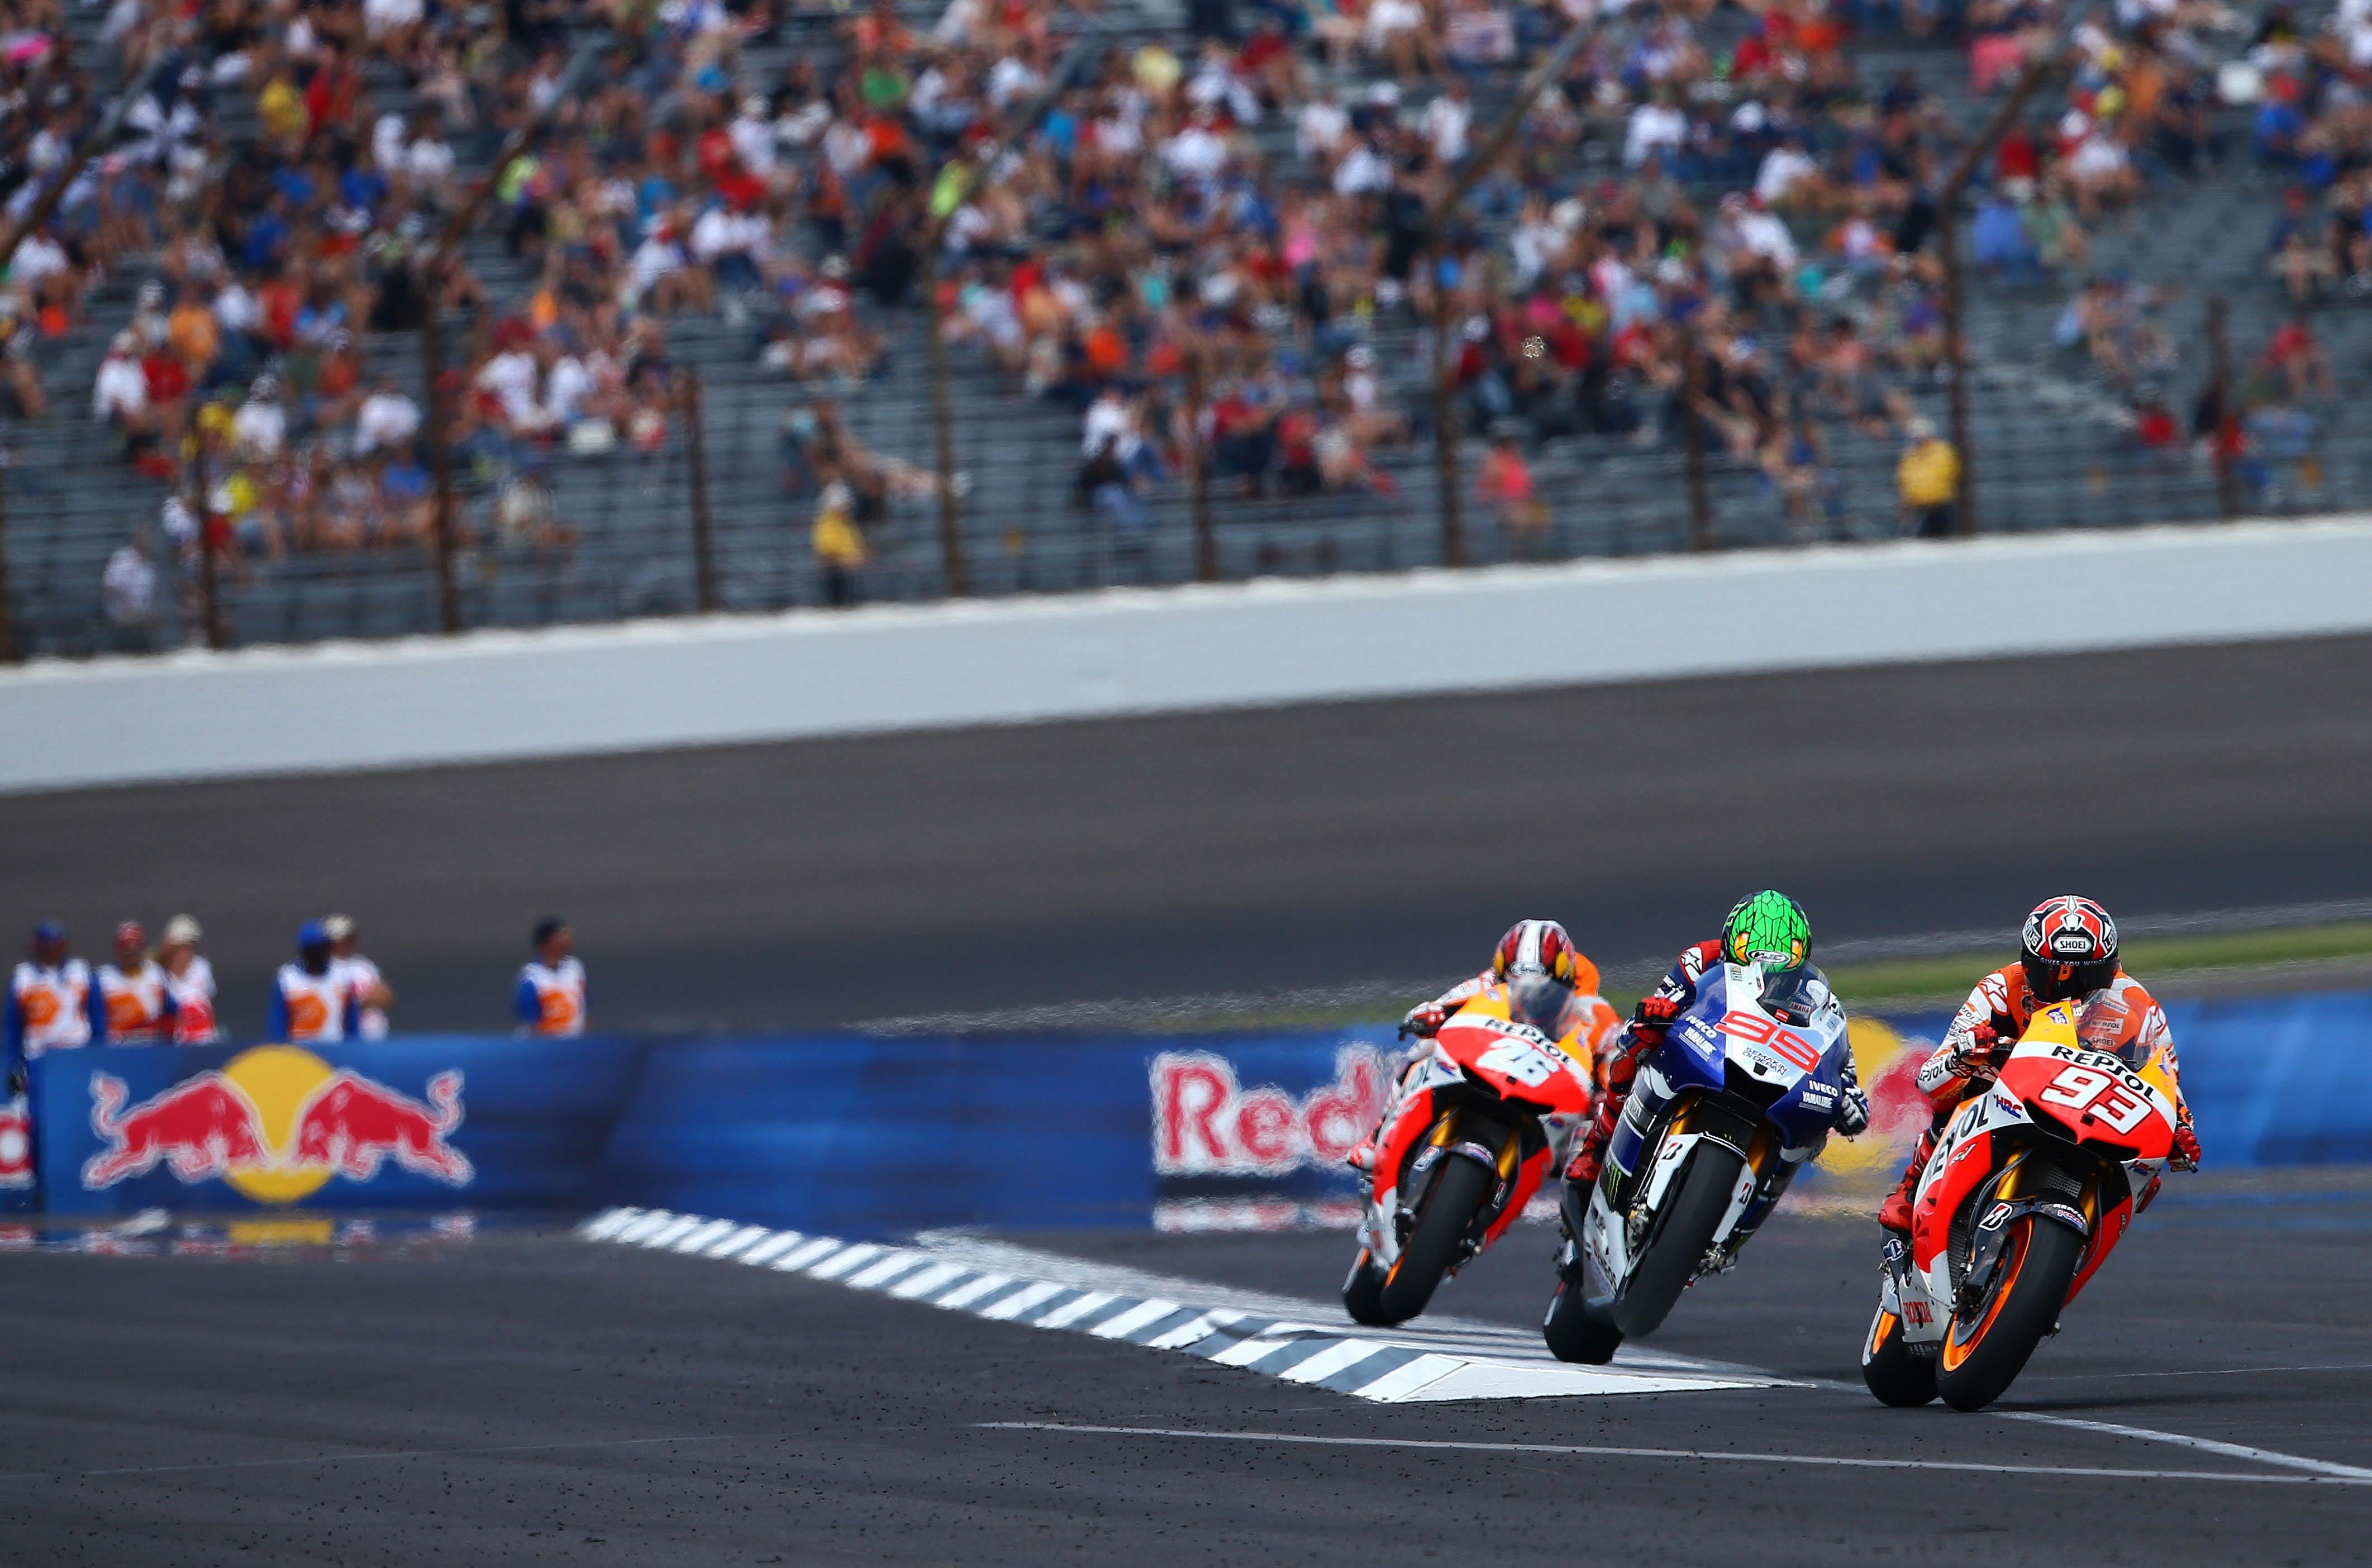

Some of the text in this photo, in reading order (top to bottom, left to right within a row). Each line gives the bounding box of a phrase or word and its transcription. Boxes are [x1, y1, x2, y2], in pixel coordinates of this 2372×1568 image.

[2060, 941, 2086, 949] SHOEI
[2040, 957, 2060, 966] GIVES
[1685, 1014, 1717, 1039] IVECO
[1485, 1019, 1569, 1064] REPSOL
[1684, 1026, 1717, 1056] YAMALUBE
[1713, 1010, 1821, 1075] 99
[1474, 1036, 1560, 1088] 26
[1746, 1047, 1788, 1072] SEMAKIN
[1753, 1055, 1785, 1075] DEPAN
[2051, 1046, 2154, 1102] REPSOL
[1802, 1091, 1833, 1109] YAMALUBE
[1808, 1080, 1838, 1097] IVECO
[2040, 1065, 2152, 1135] 93
[1155, 1052, 1377, 1169] Red
[1994, 1093, 2023, 1119] HRC
